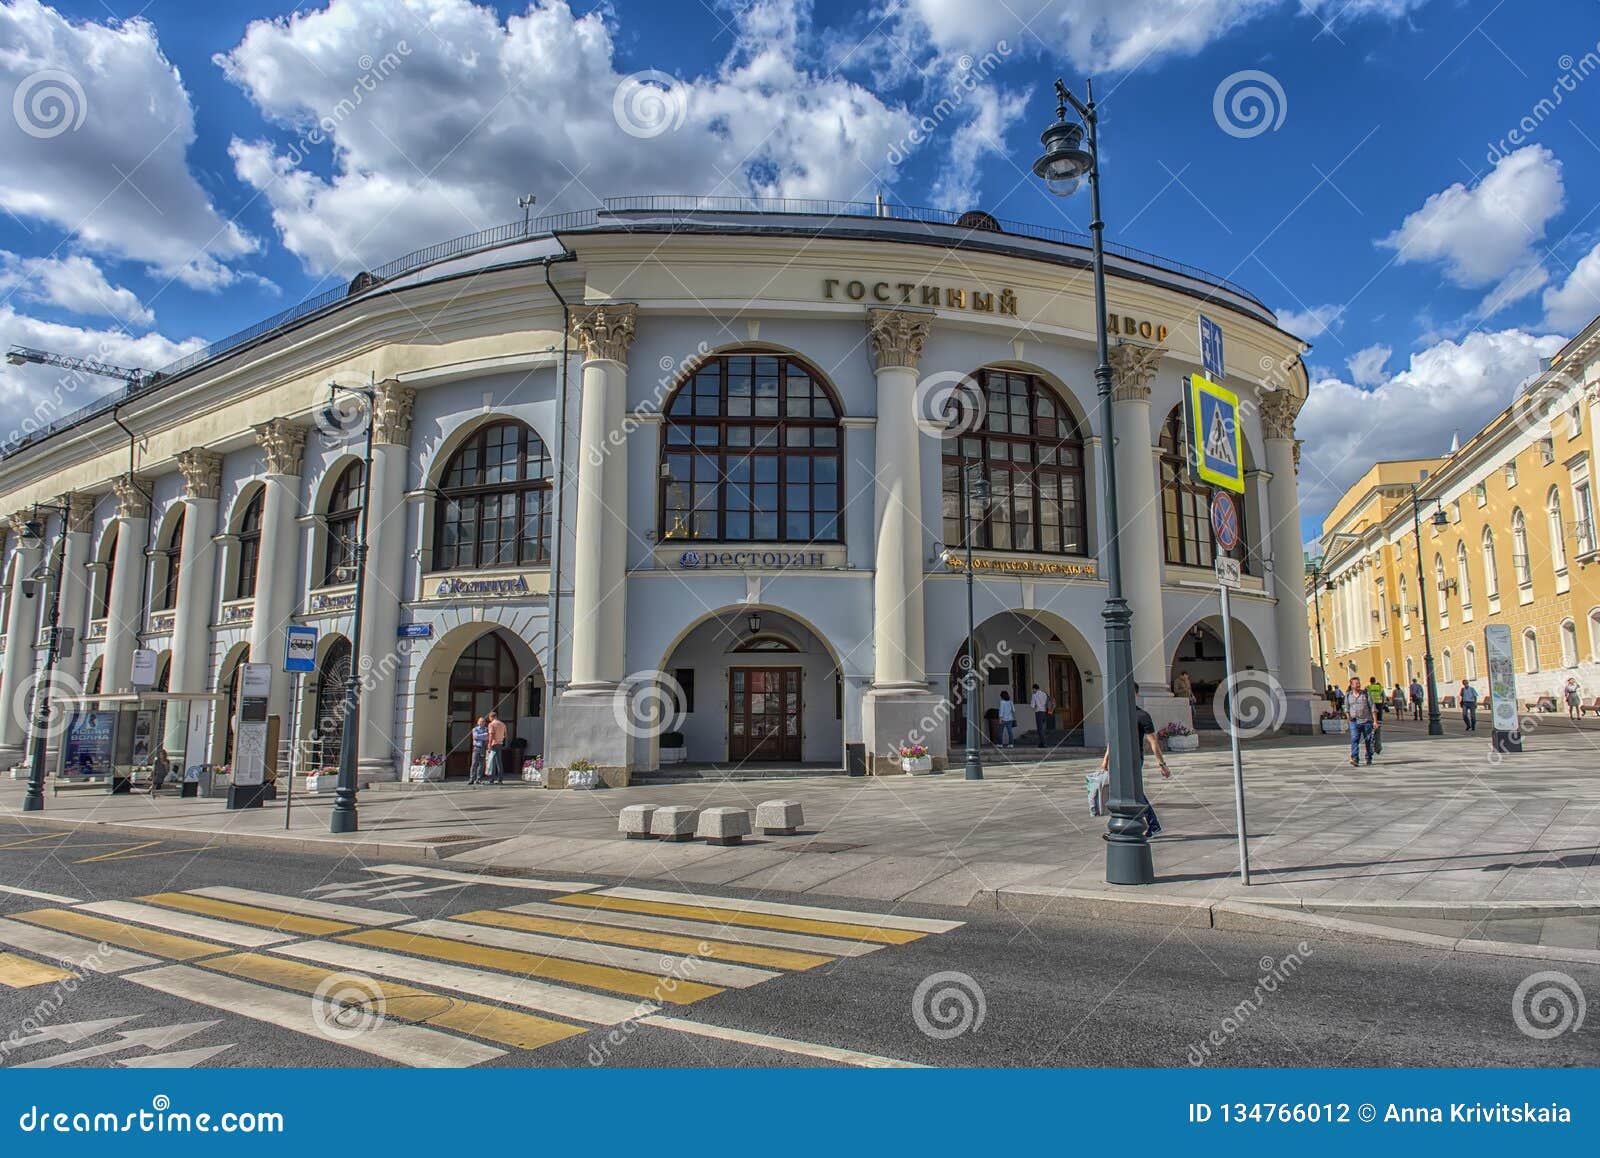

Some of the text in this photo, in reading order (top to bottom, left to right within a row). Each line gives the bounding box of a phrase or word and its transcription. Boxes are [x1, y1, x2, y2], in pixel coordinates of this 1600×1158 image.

[824, 279, 1169, 341] ГОСТИНЫЙ ДВОР
[705, 552, 824, 569] ресторан
